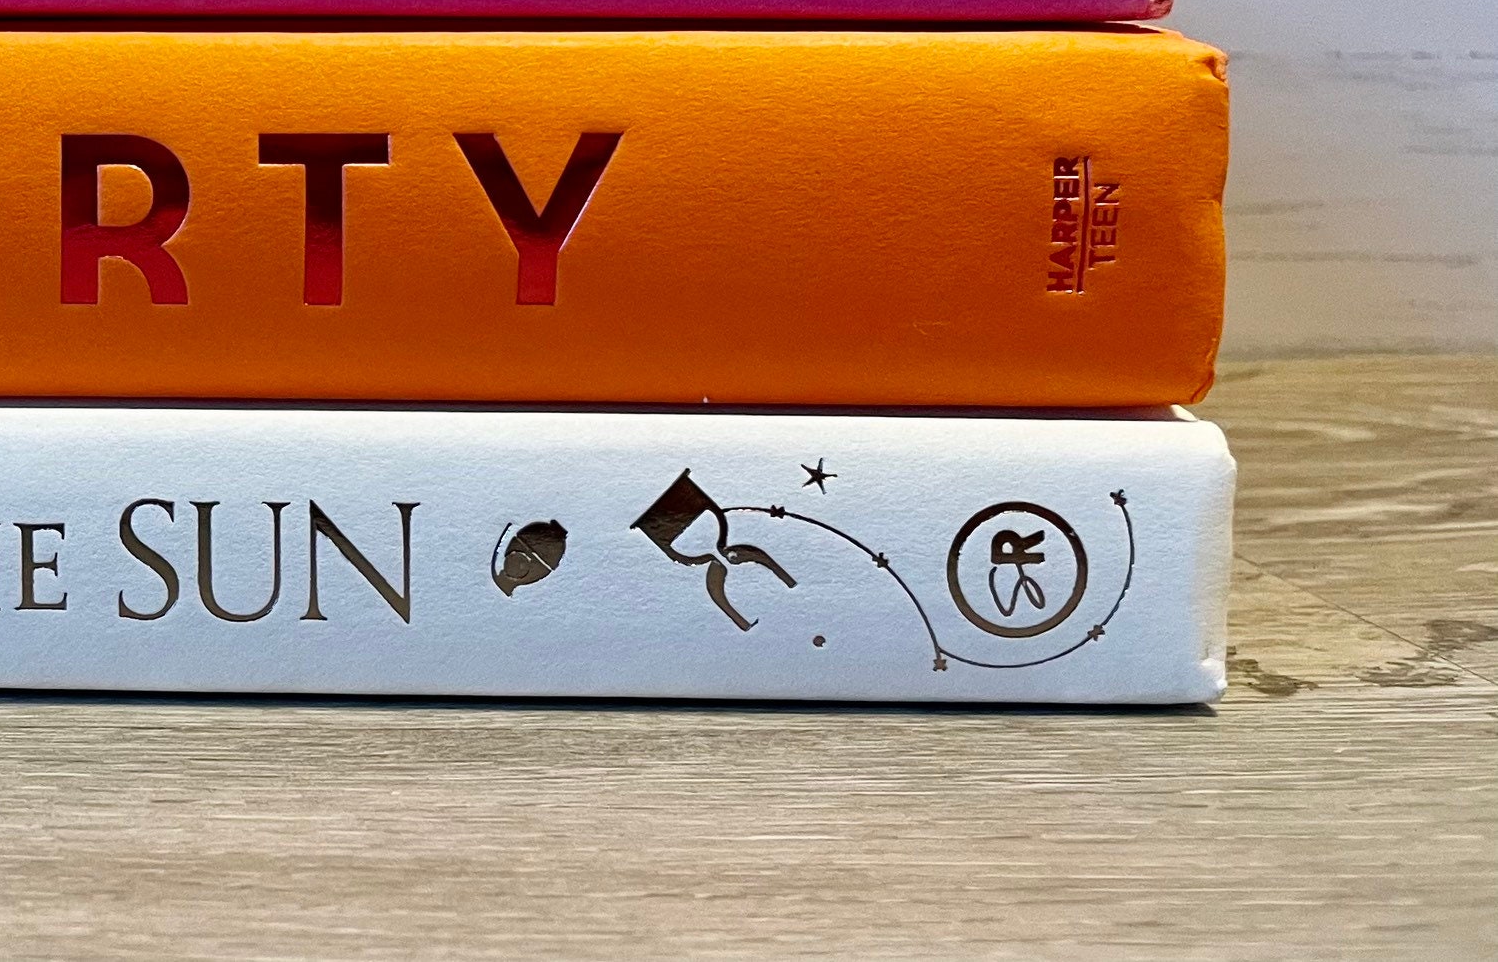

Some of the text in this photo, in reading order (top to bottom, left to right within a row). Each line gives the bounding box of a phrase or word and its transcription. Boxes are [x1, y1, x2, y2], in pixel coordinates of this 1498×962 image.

[1046, 156, 1080, 294] HARPER
[1088, 183, 1121, 270] TEEN
[117, 498, 421, 625] SUN
